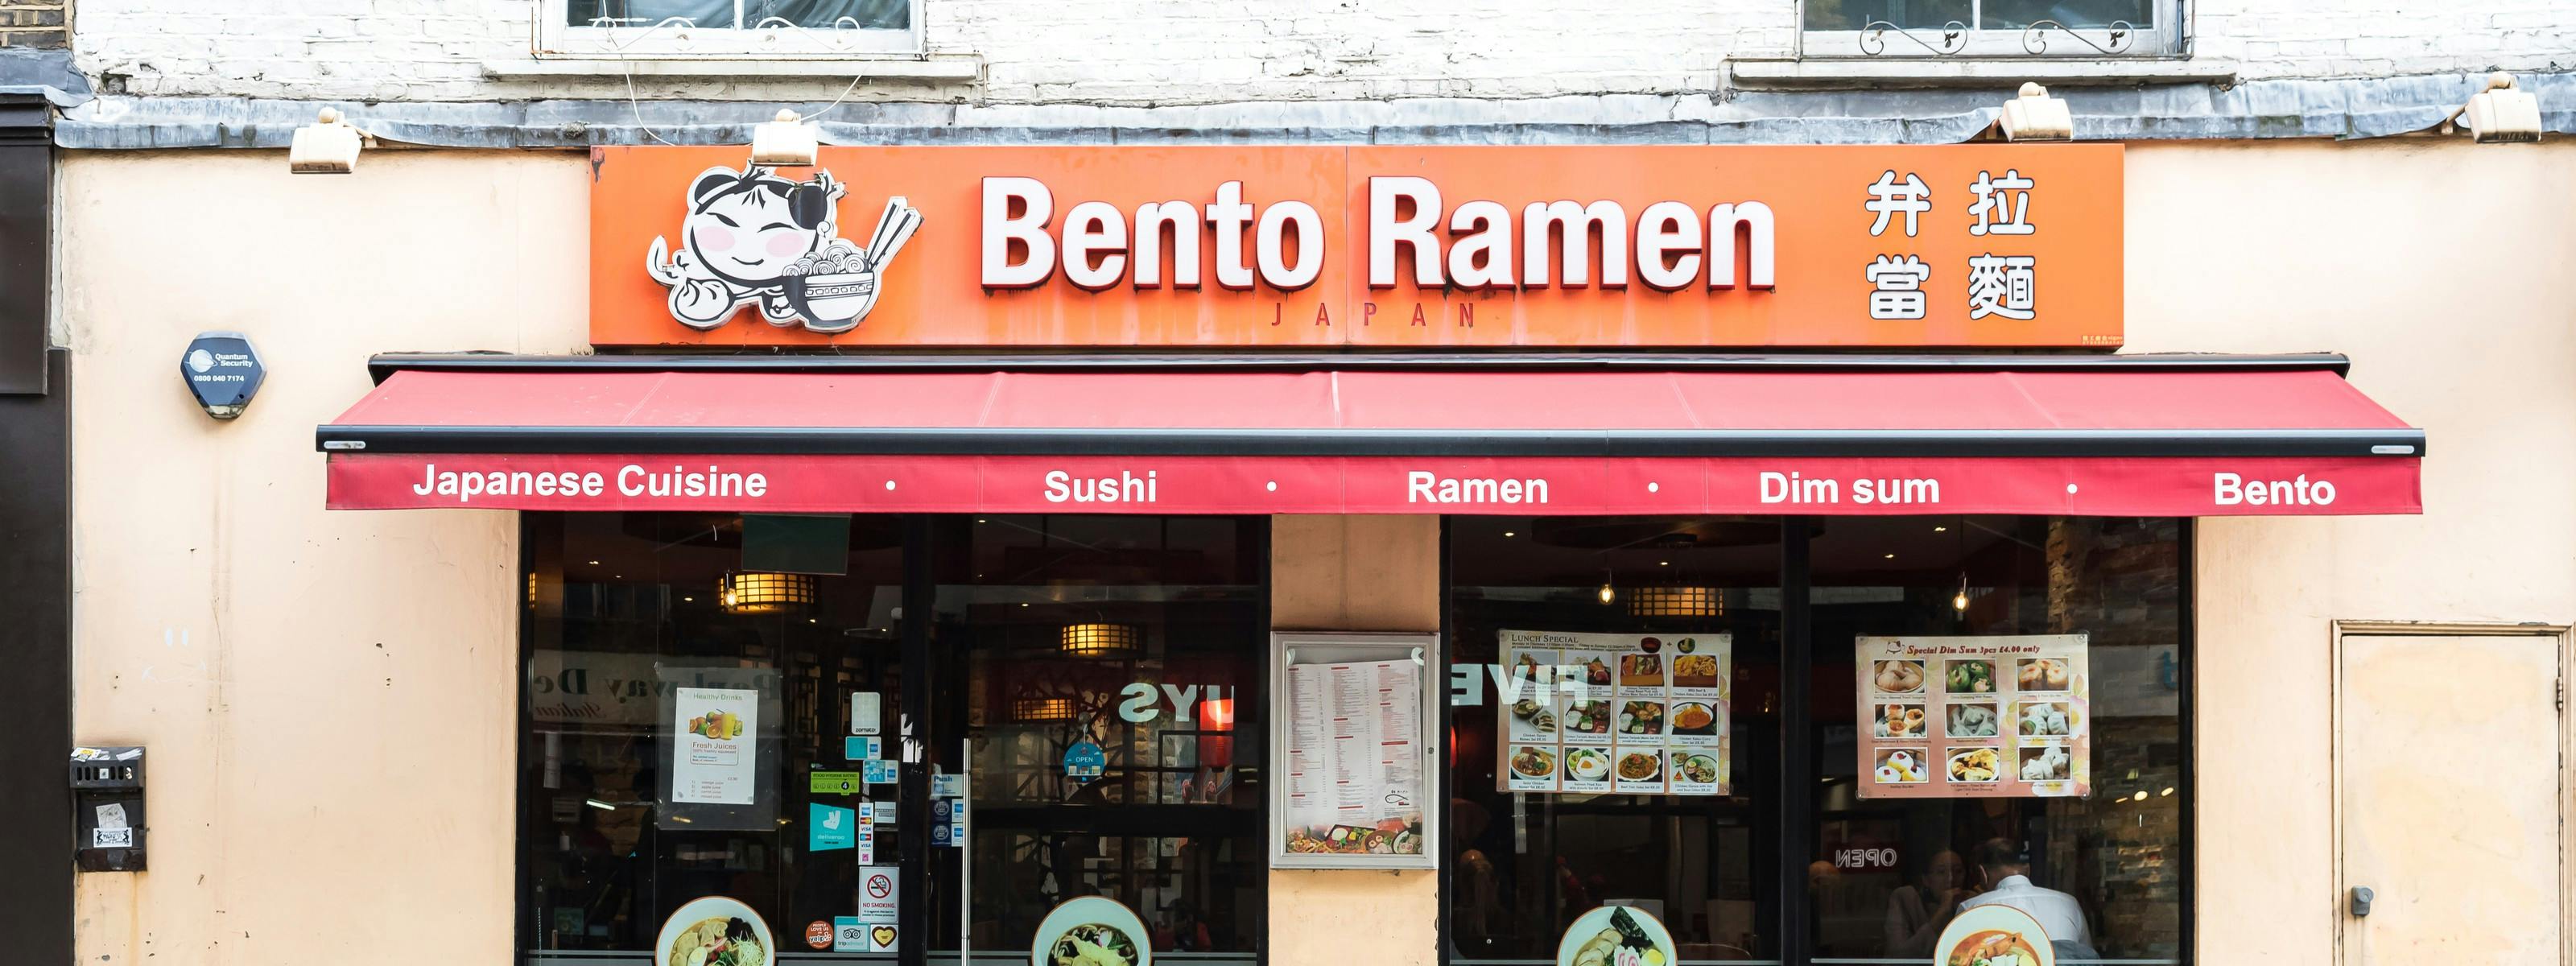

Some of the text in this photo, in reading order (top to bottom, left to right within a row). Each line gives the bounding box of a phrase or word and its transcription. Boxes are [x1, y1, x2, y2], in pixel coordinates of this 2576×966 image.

[981, 175, 1775, 291] Bento Ramen
[1967, 168, 2036, 320] 拉麵
[1271, 302, 1474, 328] JAPAN
[412, 464, 767, 503] Japanese Cuisine
[1044, 470, 1157, 503] Sushi
[1408, 471, 1548, 504] Ramen
[1760, 471, 1940, 504] Dim sum
[2215, 473, 2336, 506] Bento
[1512, 634, 1579, 643] LUNCH SPECIAL
[1907, 645, 1937, 655] Special
[1979, 646, 1996, 655] 3pcs
[2022, 646, 2040, 654] only
[693, 693, 720, 701] Healthy
